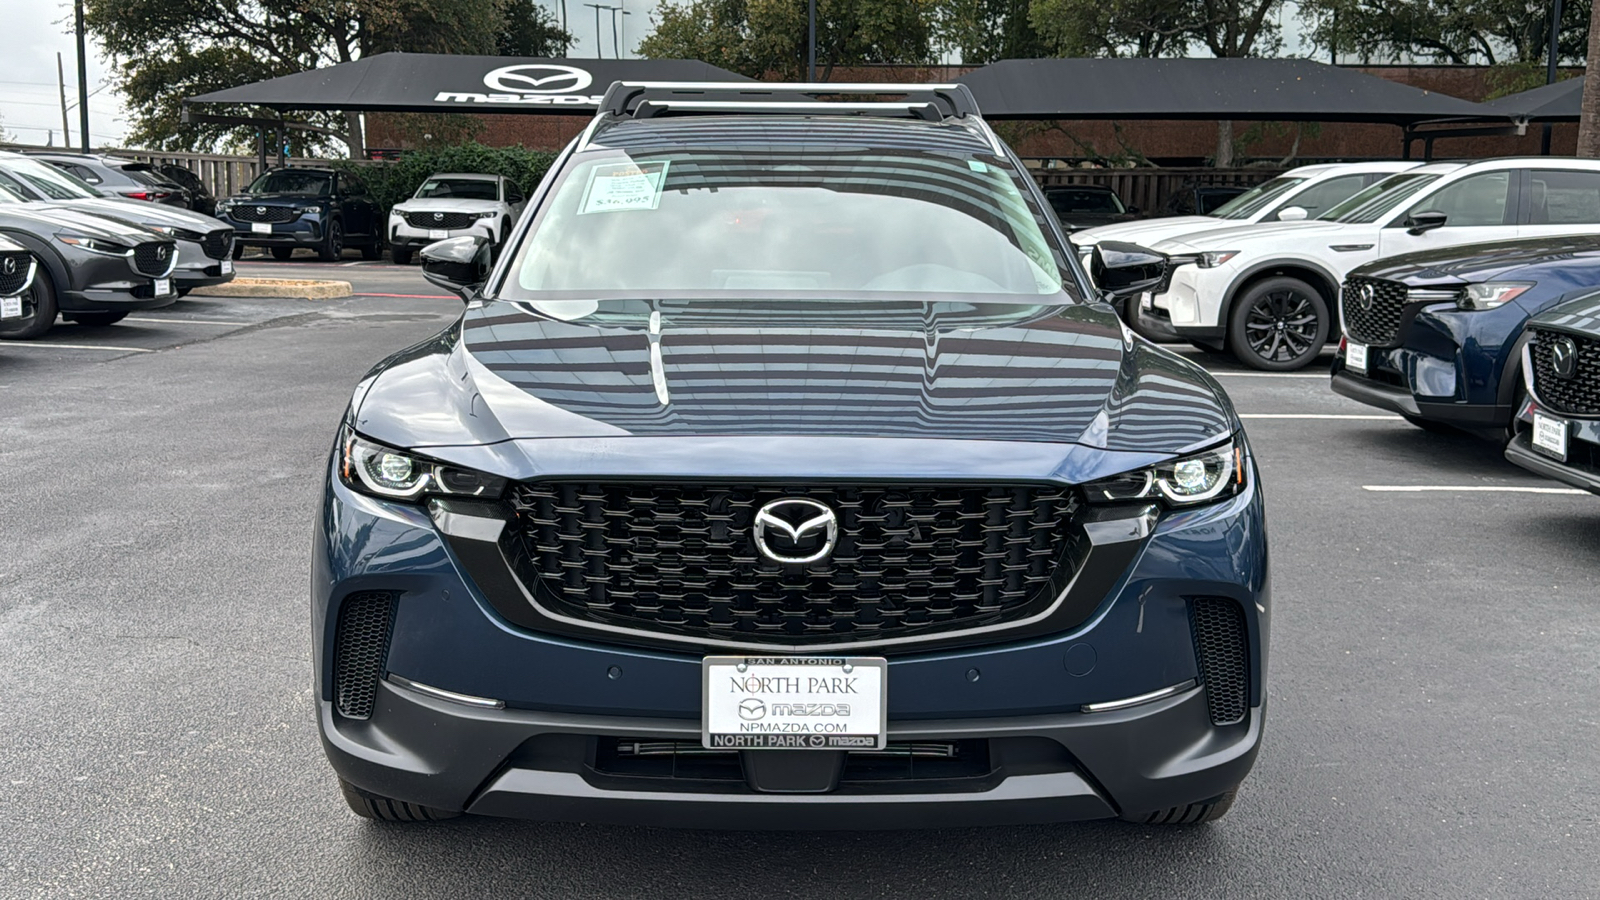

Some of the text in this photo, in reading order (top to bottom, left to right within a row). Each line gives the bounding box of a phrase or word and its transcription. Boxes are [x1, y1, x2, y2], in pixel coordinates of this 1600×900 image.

[730, 676, 859, 694] NORTH PARK
[772, 703, 851, 716] mazda
[740, 723, 847, 733] NPMAZDA.COM
[714, 735, 874, 746] NORTH PARK mazda
